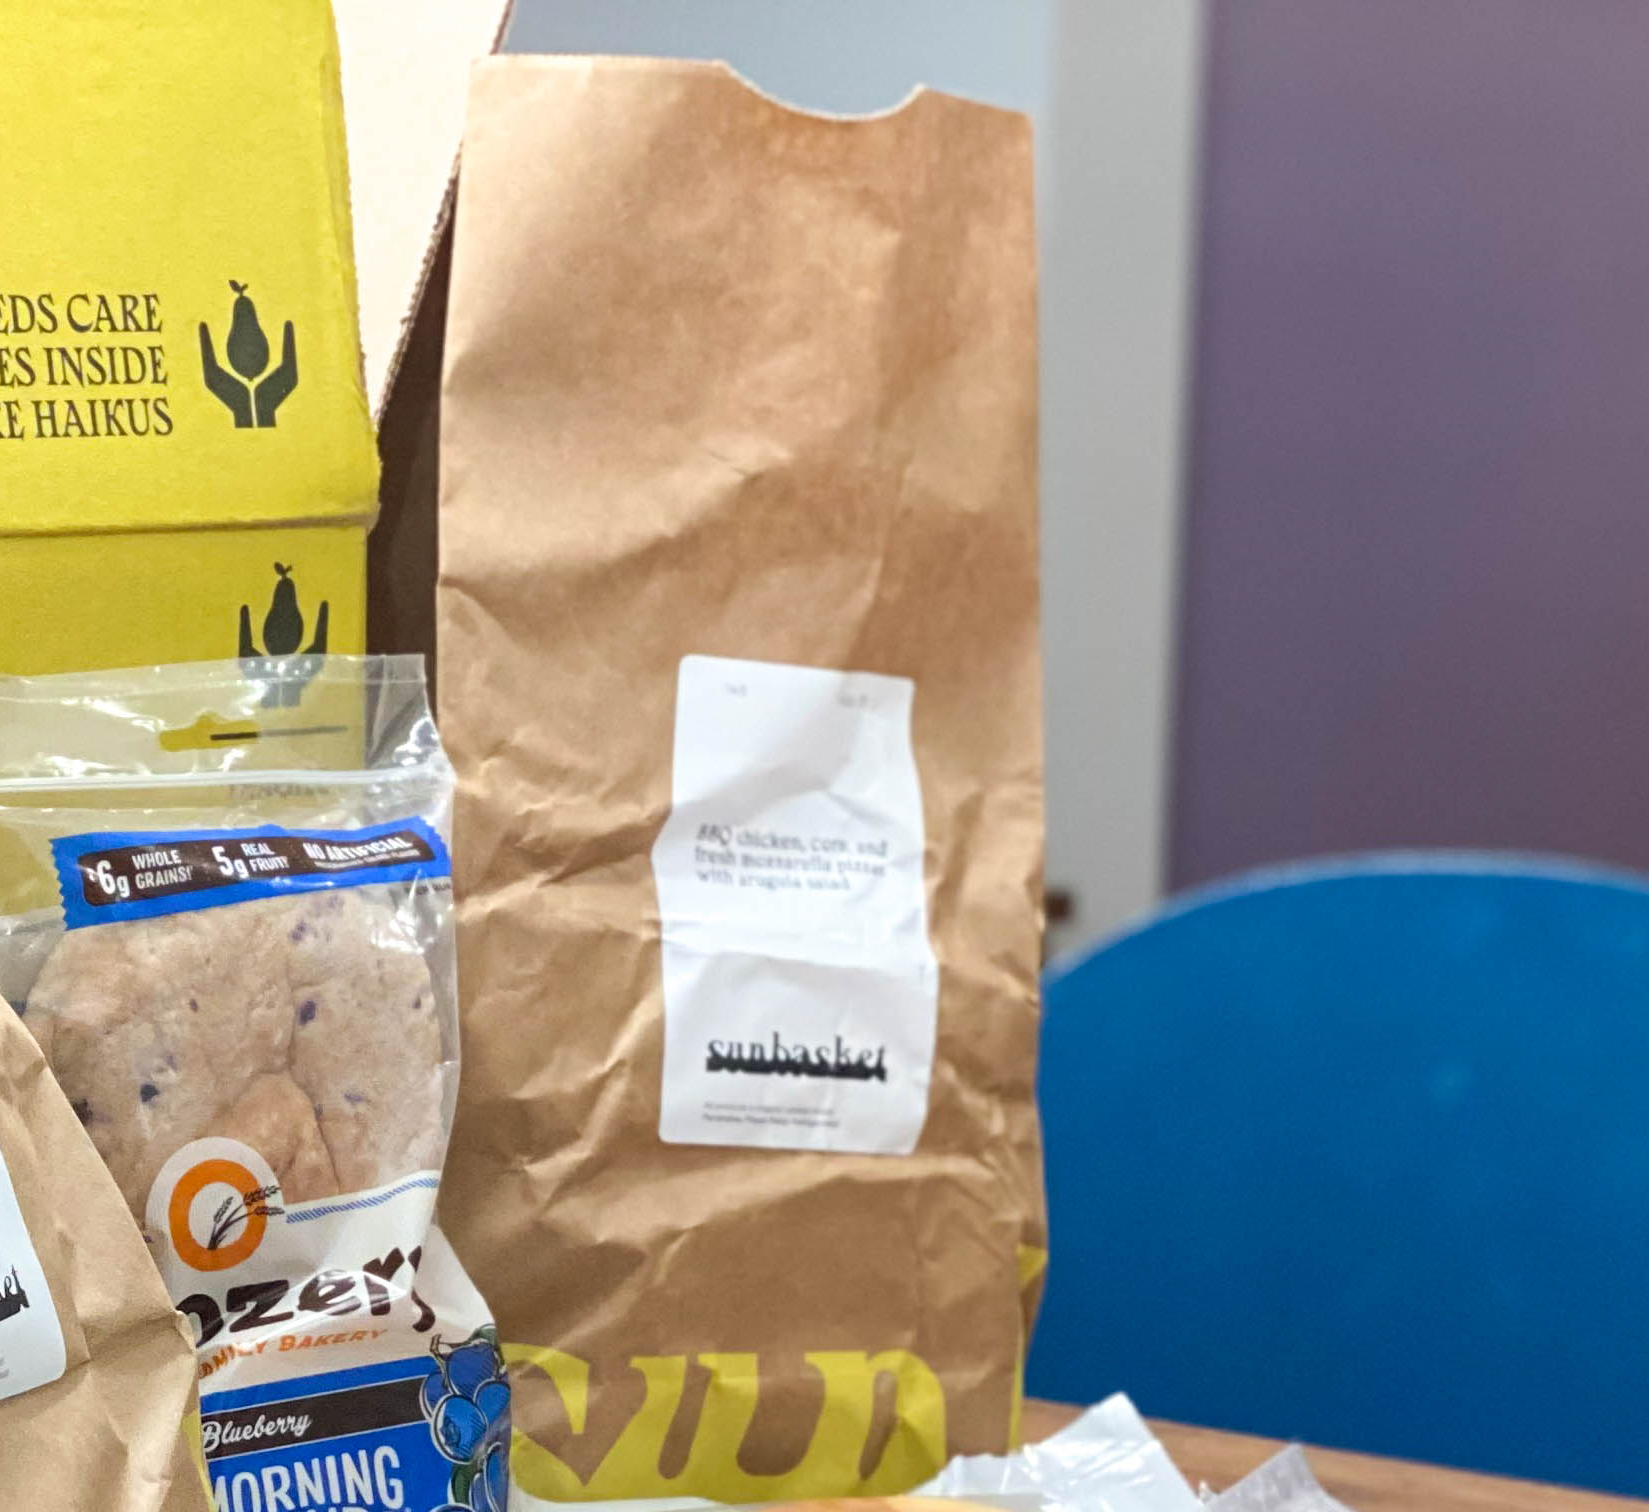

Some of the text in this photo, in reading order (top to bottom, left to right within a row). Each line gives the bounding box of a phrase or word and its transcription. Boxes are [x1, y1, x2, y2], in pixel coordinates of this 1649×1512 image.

[67, 292, 163, 334] CARE
[43, 345, 169, 387] INSIDE
[31, 397, 175, 440] HAIKUS
[131, 849, 183, 871] WHOLE
[211, 845, 251, 879] 5g
[240, 842, 276, 857] REAL
[325, 836, 413, 861] ARTIFICIAL
[705, 1030, 888, 1083] sunbasket
[199, 1328, 390, 1380] AMILY BAKERY
[202, 1414, 312, 1453] Blueberry
